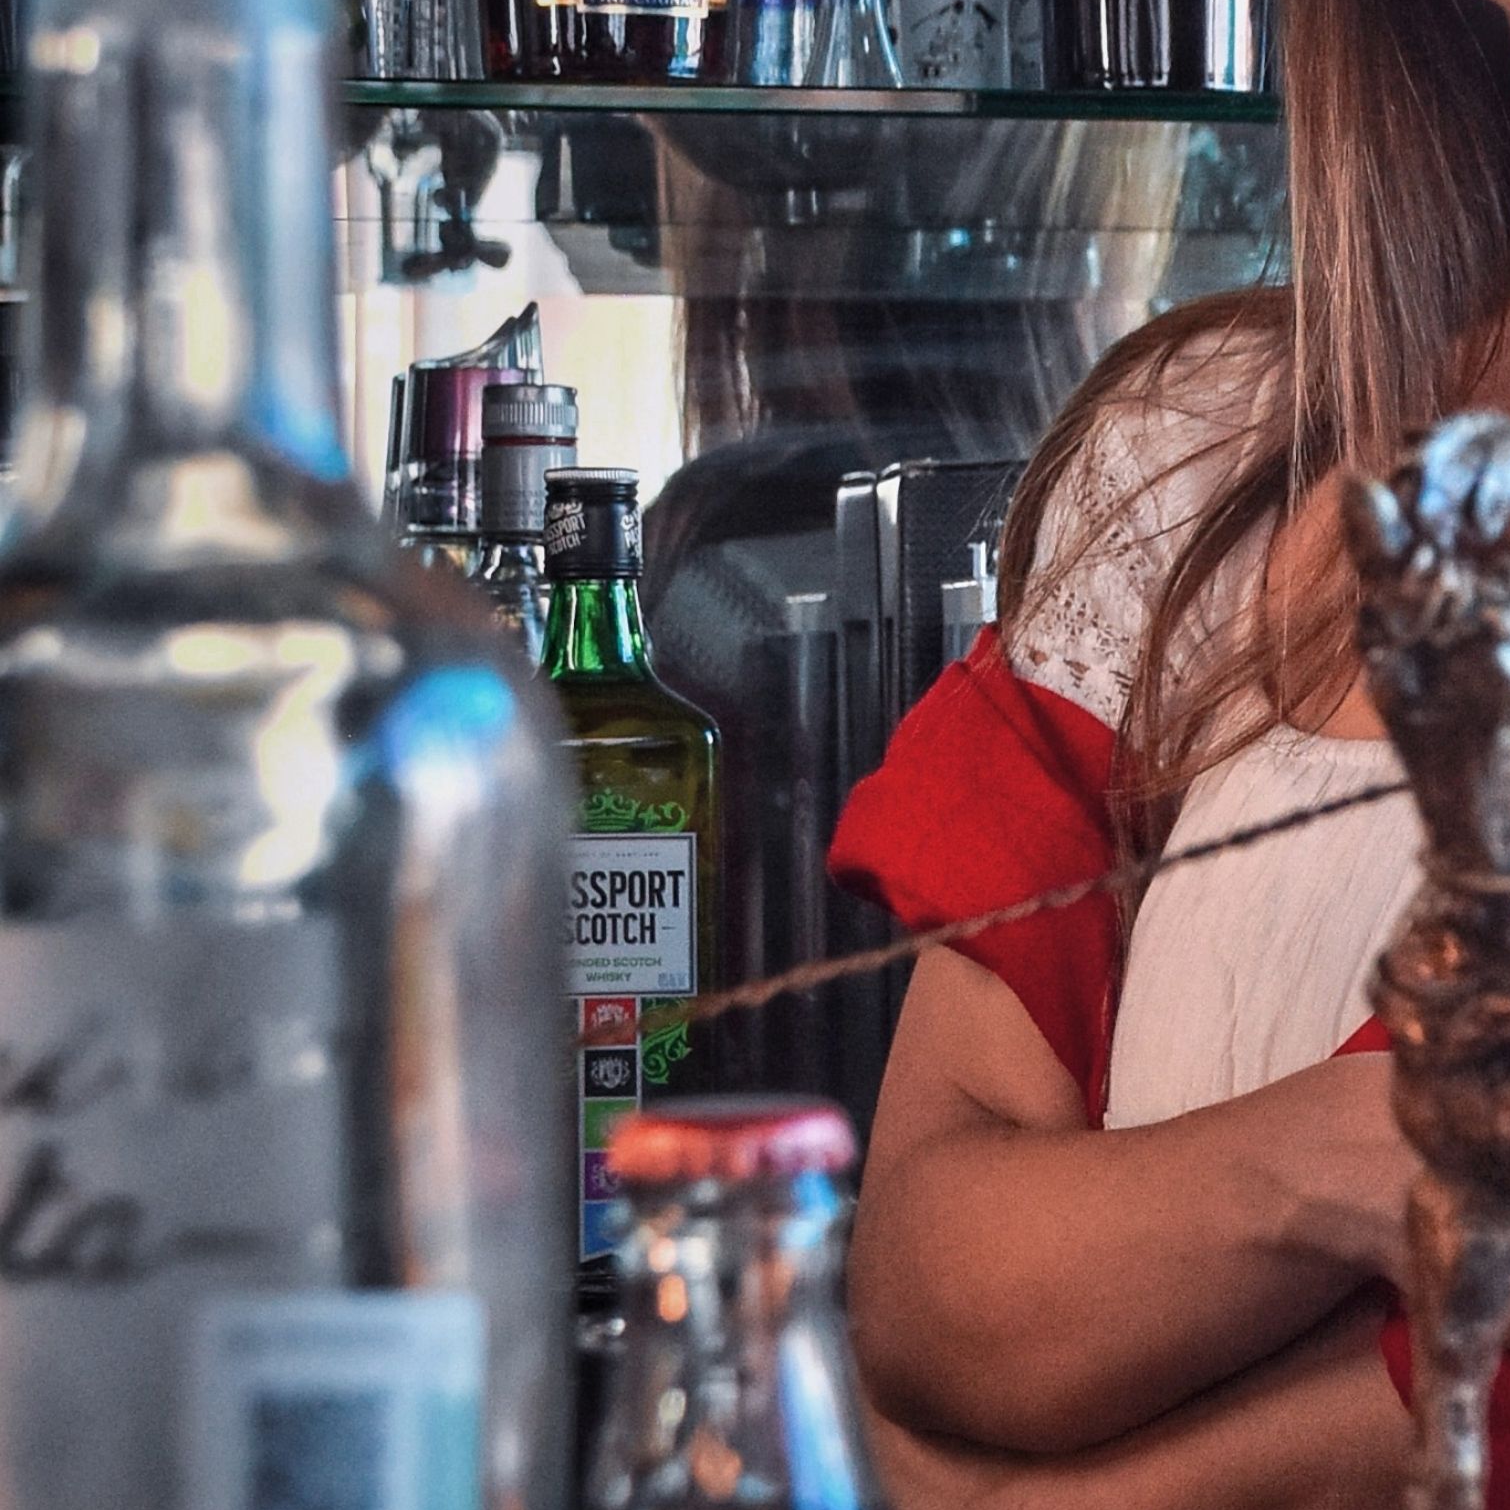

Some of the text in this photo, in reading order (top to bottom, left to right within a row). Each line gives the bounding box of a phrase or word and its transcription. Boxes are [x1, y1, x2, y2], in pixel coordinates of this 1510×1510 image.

[571, 870, 685, 909] SSPORT
[613, 956, 662, 968] SCOTCH
[586, 972, 632, 983] WHISKY
